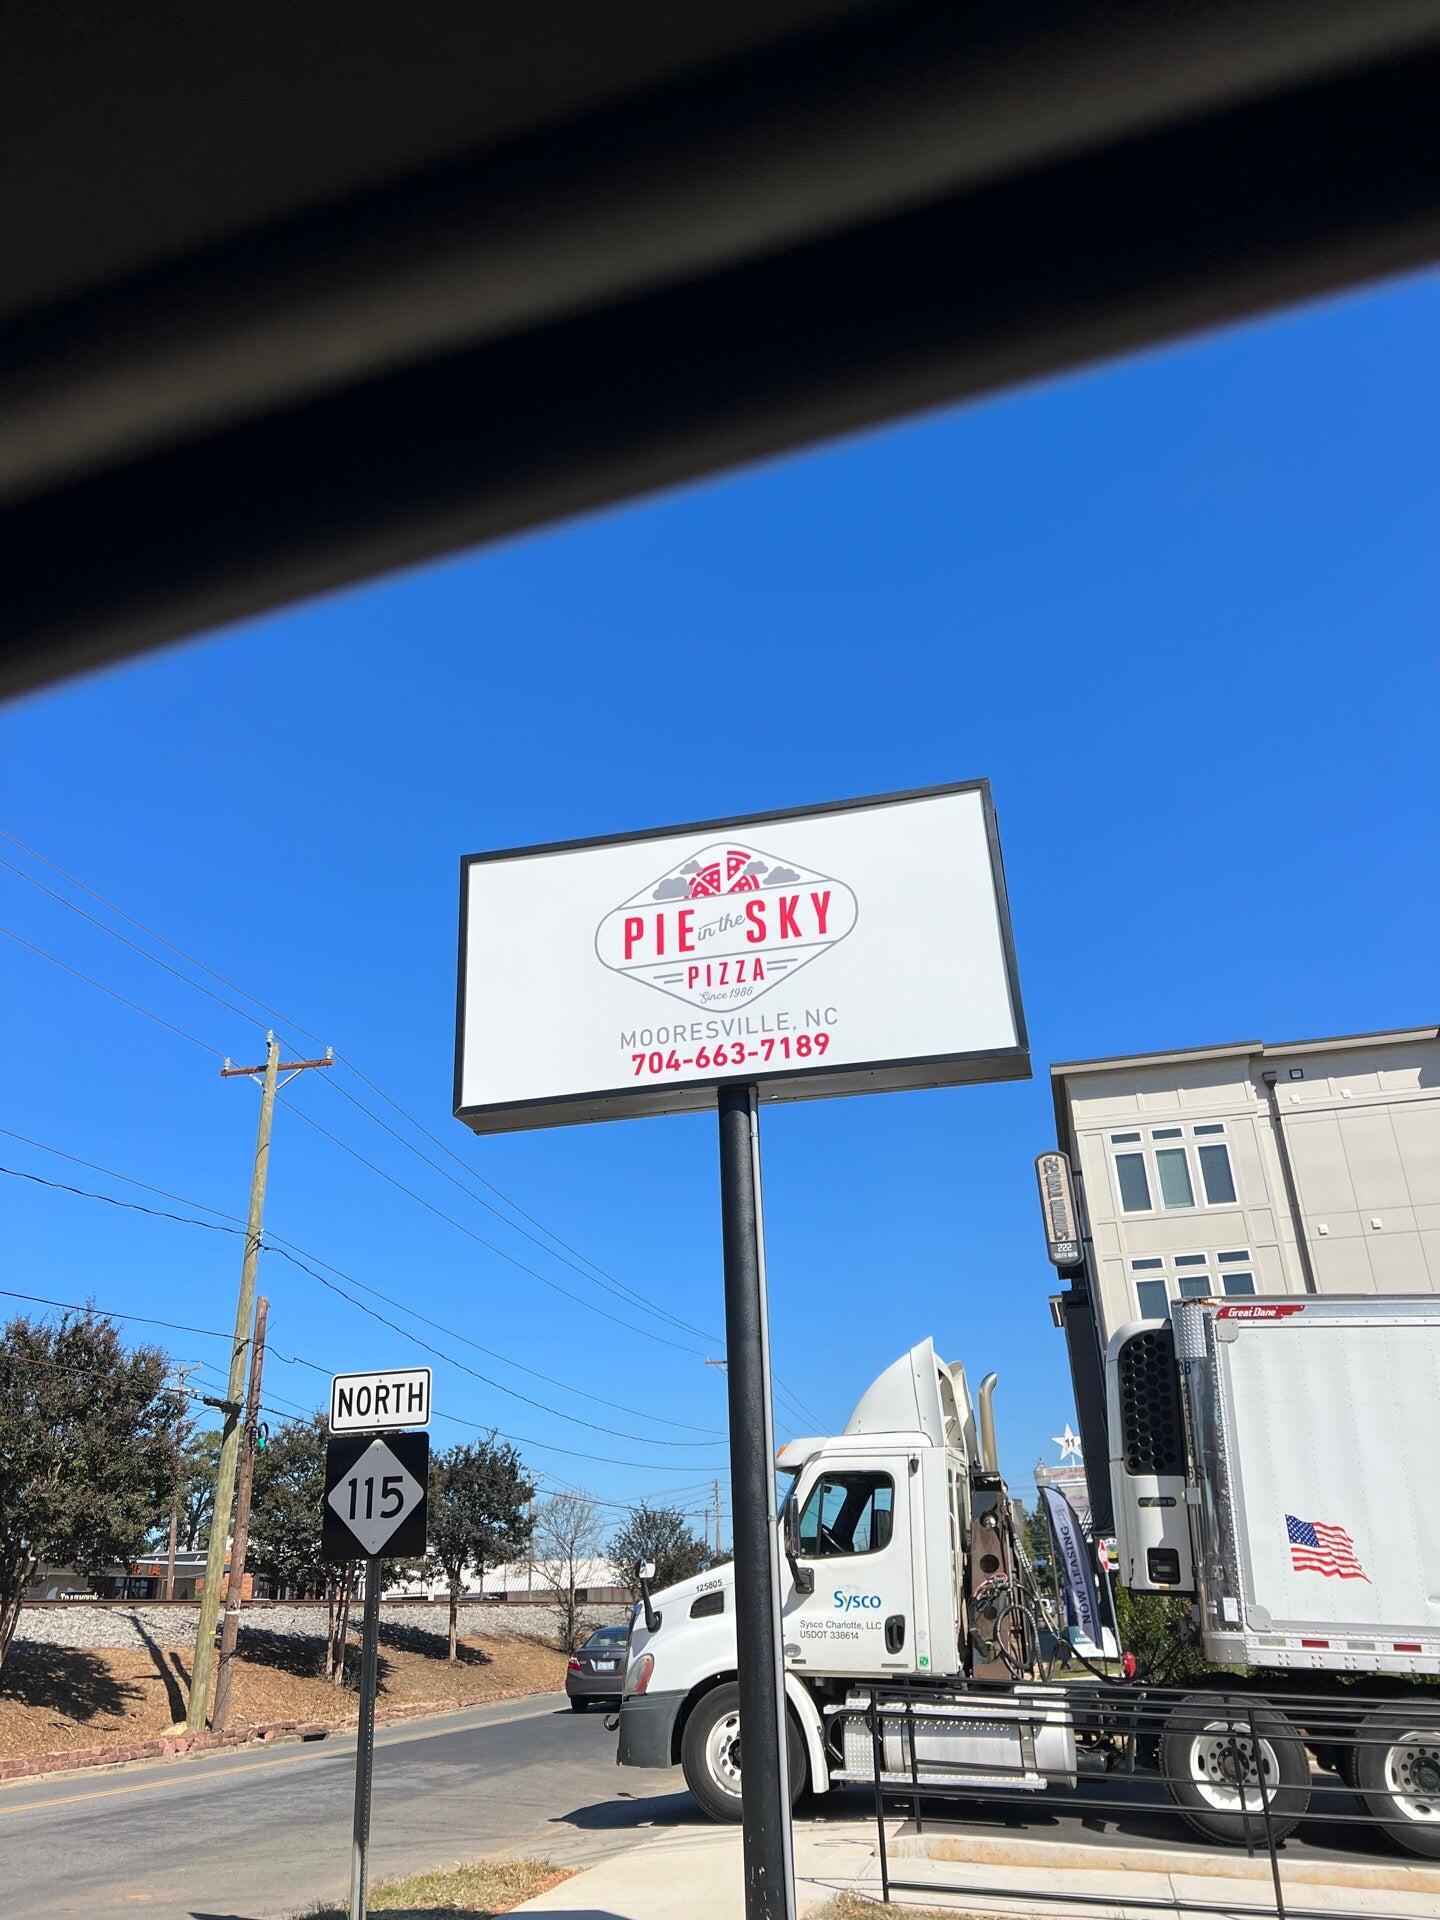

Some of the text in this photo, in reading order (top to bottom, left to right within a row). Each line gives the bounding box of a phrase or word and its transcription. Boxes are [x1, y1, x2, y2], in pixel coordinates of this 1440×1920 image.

[624, 890, 831, 960] PIE in the SKY
[688, 957, 765, 989] PIZZA
[699, 986, 753, 1004] Since 1986
[620, 1007, 838, 1049] MOORESVILLE, NC
[632, 1032, 830, 1076] 704-663-7189
[1057, 1243, 1072, 1252] 222
[1228, 1307, 1276, 1317] Great Dane
[338, 1381, 423, 1418] NORTH
[348, 1475, 404, 1520] 115
[1060, 1526, 1082, 1585] LEASING
[696, 1579, 722, 1592] 125805
[833, 1590, 882, 1612] Sysco
[1078, 1591, 1091, 1625] NOW
[799, 1630, 859, 1640] USDOT 338614
[800, 1620, 882, 1630] Sysco Charlotte, LLC
